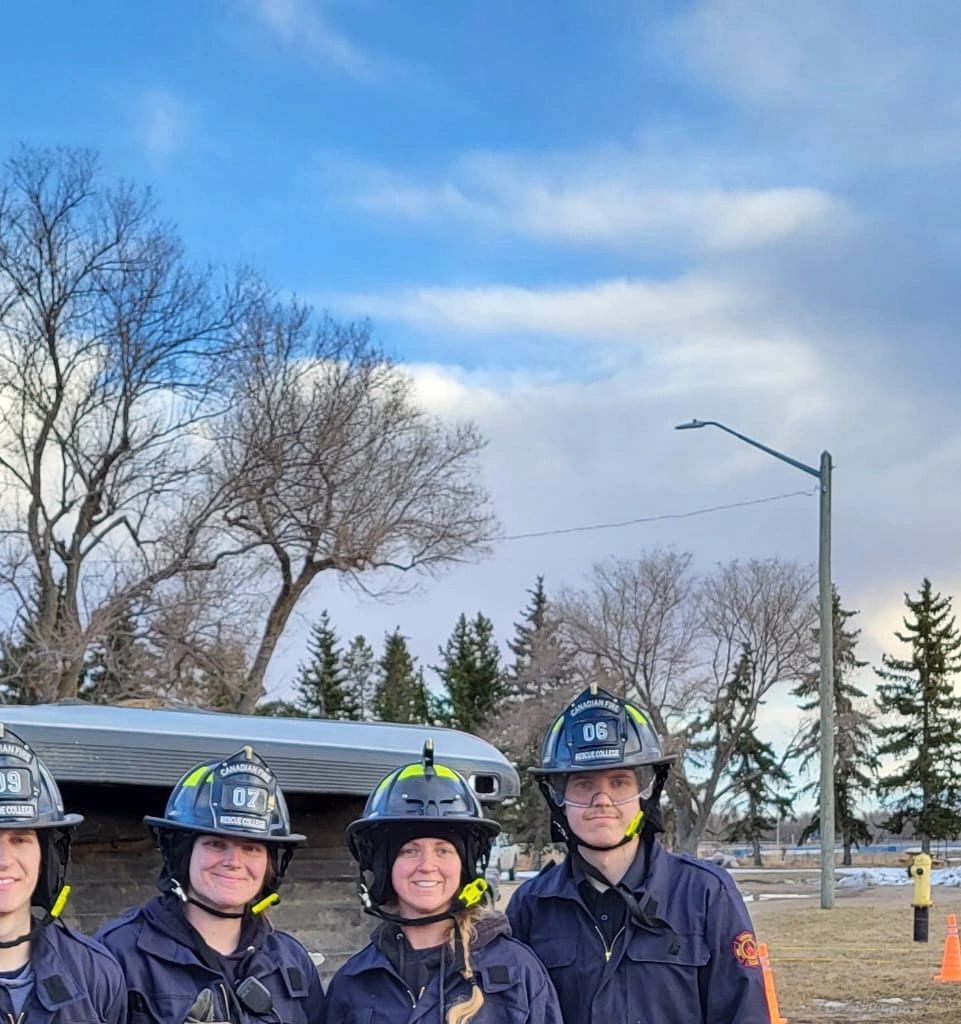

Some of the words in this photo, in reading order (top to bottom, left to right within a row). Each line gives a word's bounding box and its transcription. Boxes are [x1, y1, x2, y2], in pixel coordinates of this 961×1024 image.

[570, 699, 604, 716] CANADIAN
[582, 721, 608, 742] 06
[575, 751, 596, 761] RESCUE
[220, 763, 258, 777] CANADIAN
[232, 786, 260, 808] 07
[6, 805, 34, 816] COLLEGE
